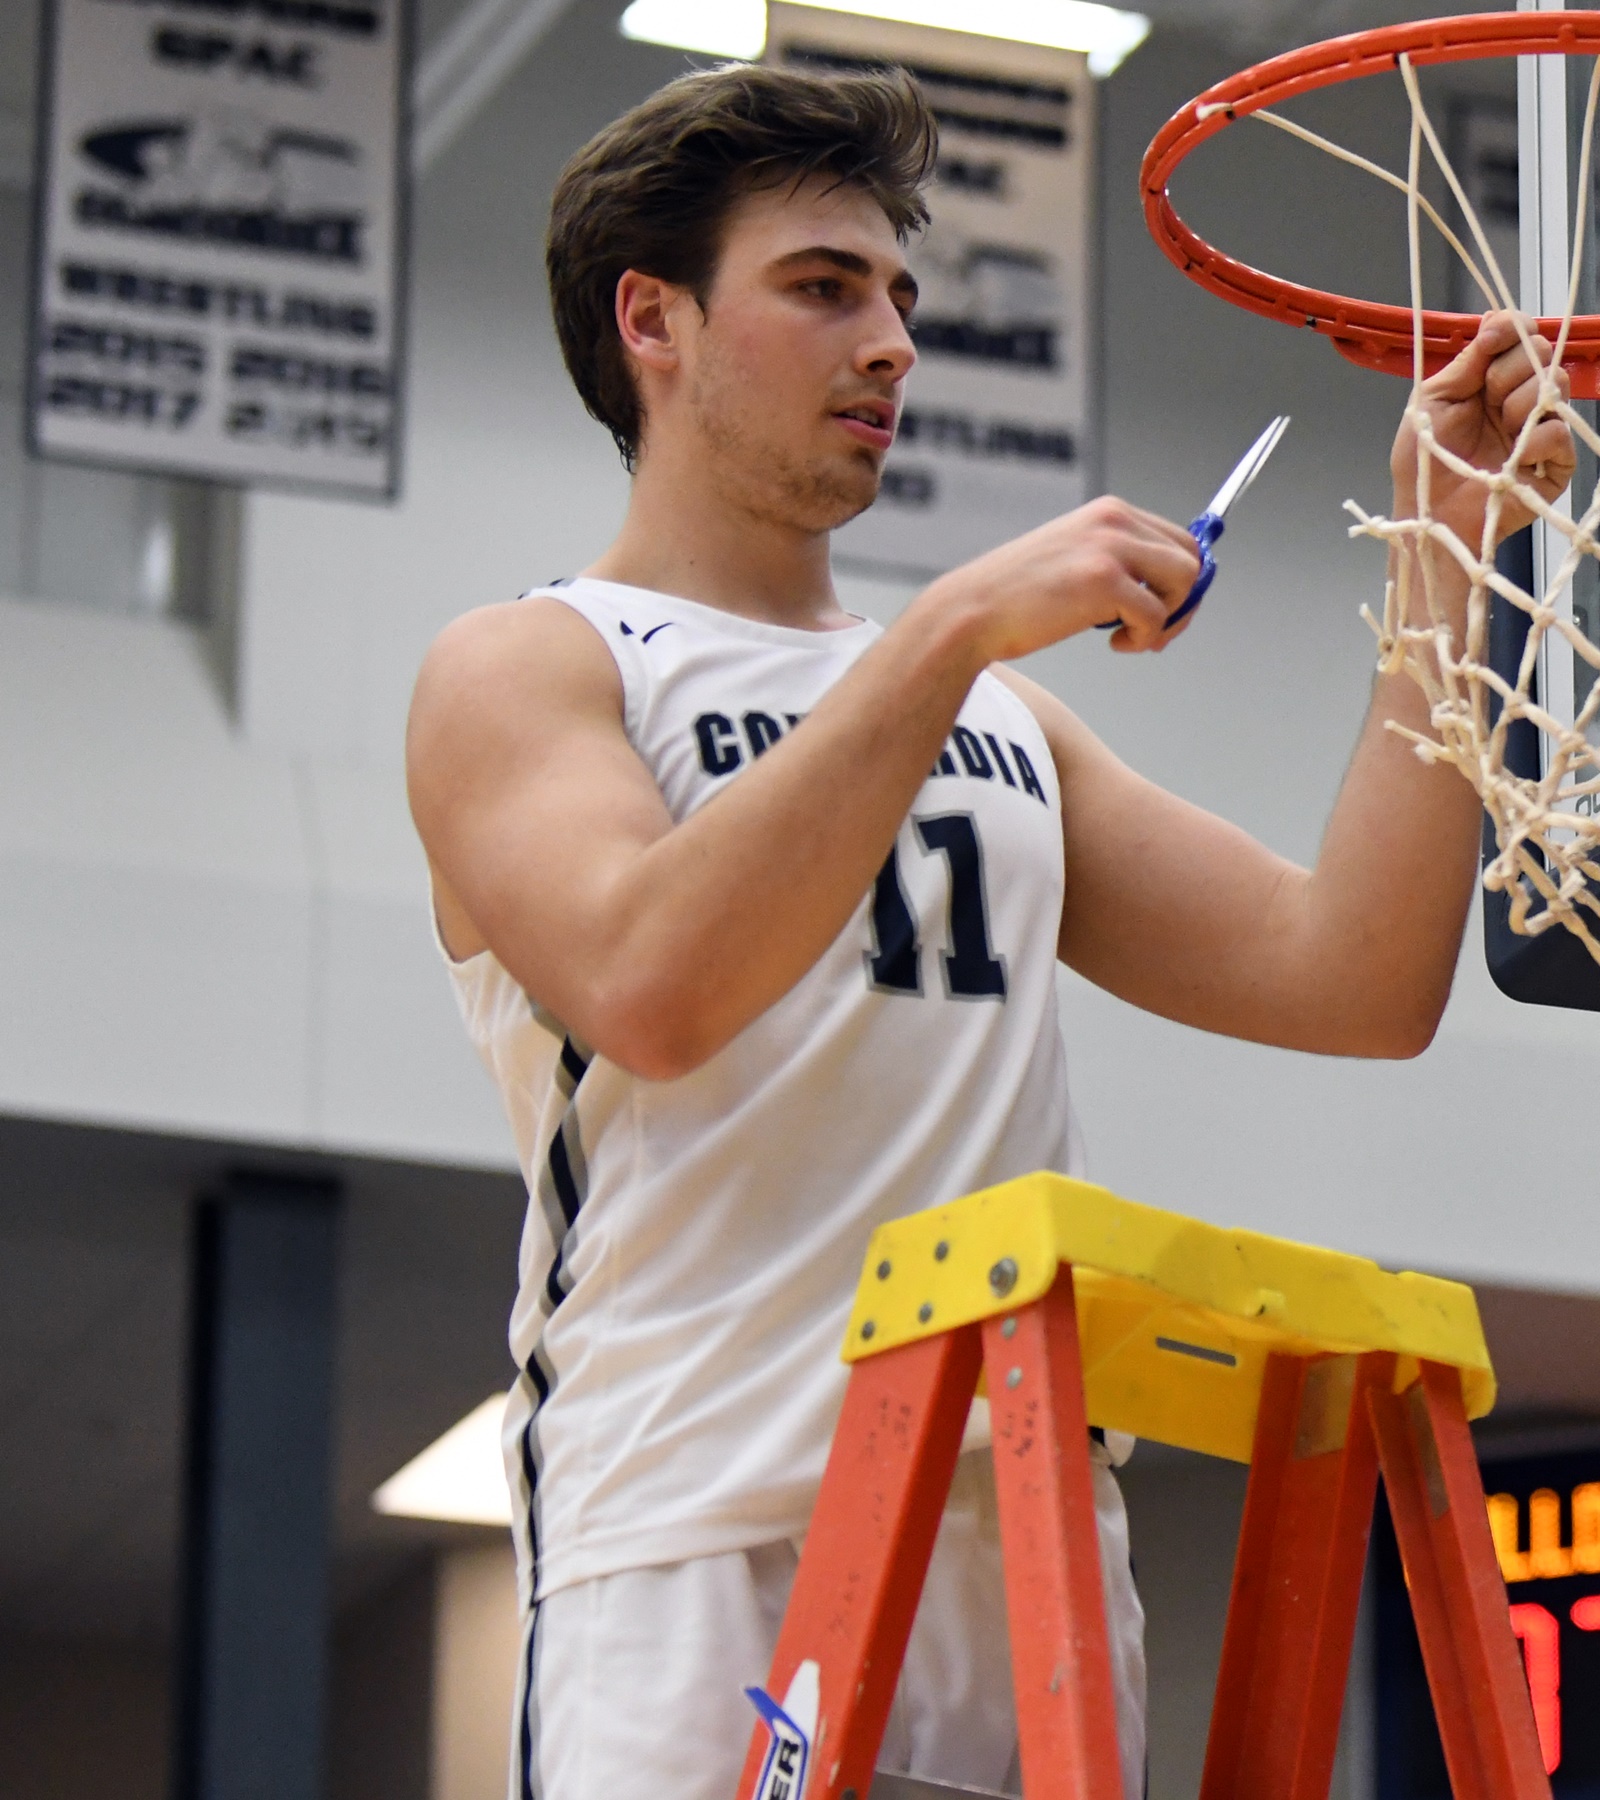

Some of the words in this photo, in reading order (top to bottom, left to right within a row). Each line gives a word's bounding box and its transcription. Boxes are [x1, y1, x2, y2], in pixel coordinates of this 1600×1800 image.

[62, 262, 376, 338] WRESTLING
[691, 711, 1050, 808] CODIA
[862, 810, 1007, 1002] 11
[768, 1738, 799, 1800] ER
